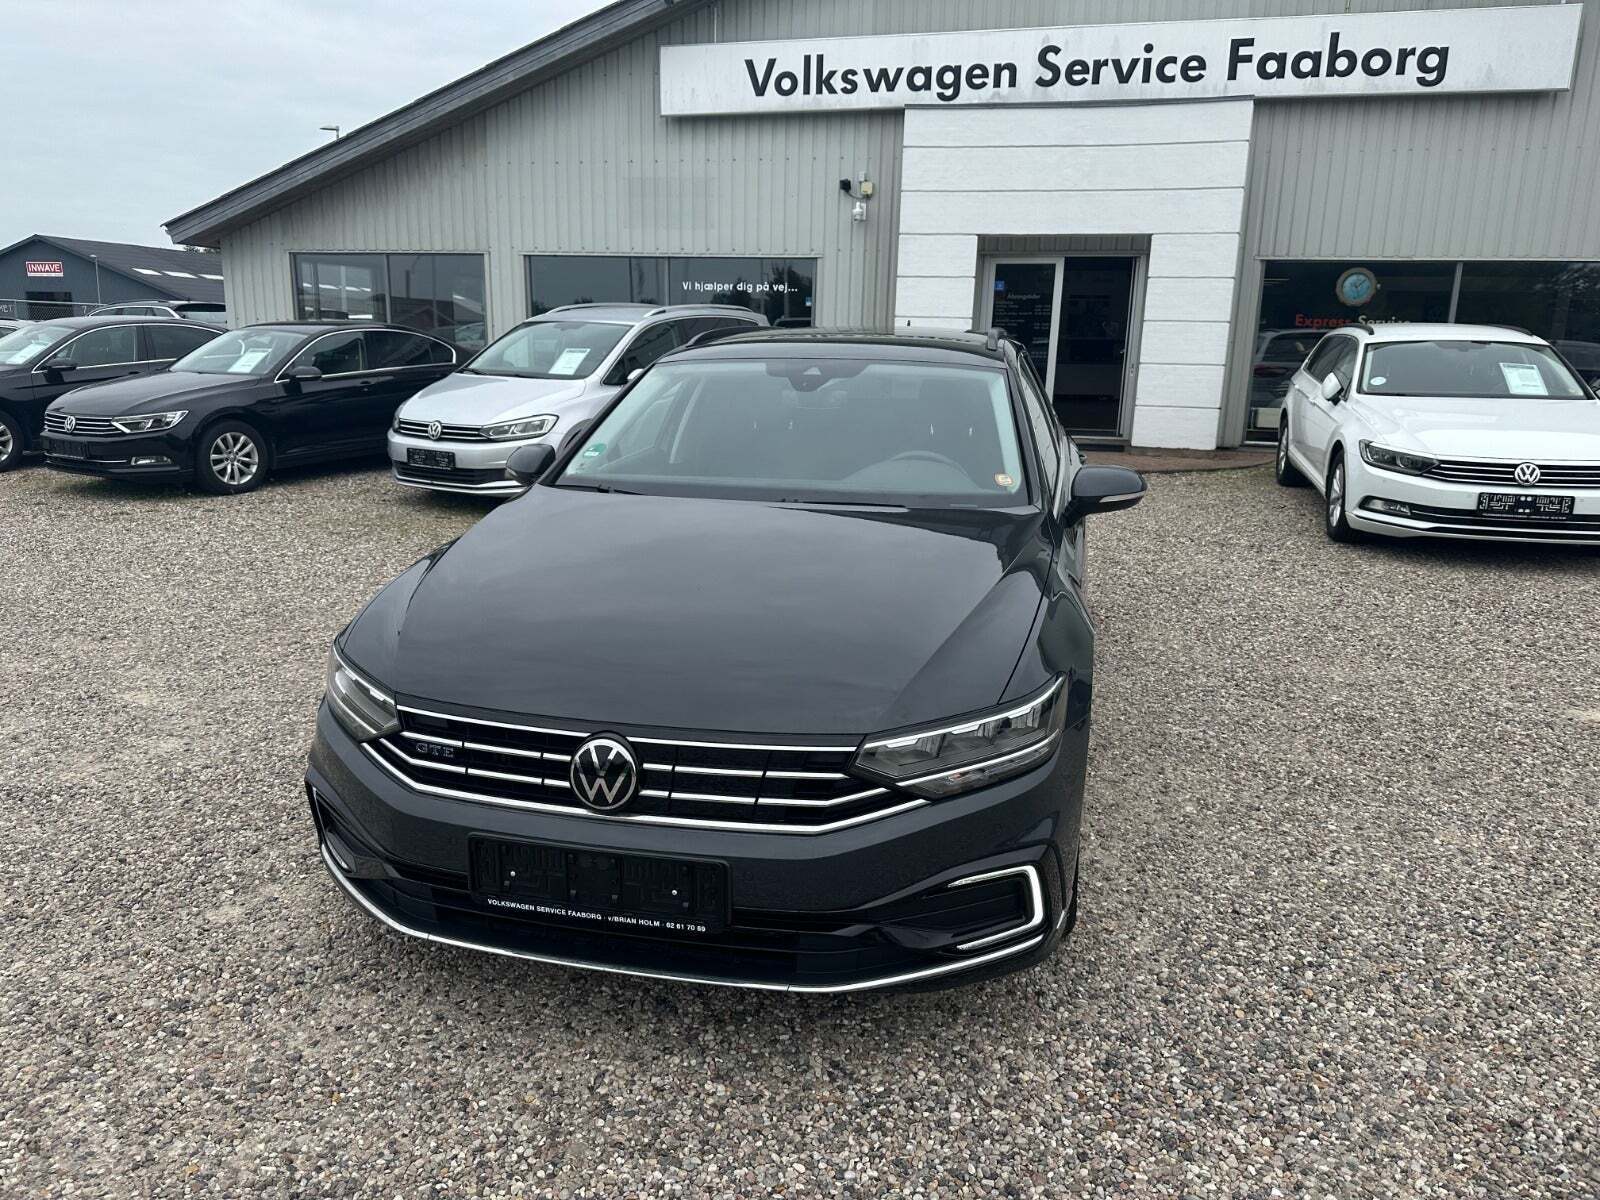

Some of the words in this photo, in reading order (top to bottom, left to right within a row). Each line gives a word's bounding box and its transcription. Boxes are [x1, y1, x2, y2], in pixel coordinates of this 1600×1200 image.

[744, 54, 1017, 101] Volkswagen
[1035, 42, 1206, 87] Service
[1226, 32, 1449, 87] Faaborg
[28, 263, 61, 272] INWAVE
[682, 281, 691, 290] Vi
[695, 281, 733, 292] hjælper
[736, 281, 753, 292] dig
[756, 281, 769, 292] på
[772, 281, 798, 293] vej...
[1514, 462, 1541, 486] VW
[415, 742, 455, 758] GTE
[571, 739, 637, 807] VW
[487, 898, 535, 911] VOLKSWAGEN
[536, 905, 567, 916] SERVICE
[568, 910, 602, 920] FAABORG
[607, 915, 637, 925] v/BRIAN
[638, 919, 660, 928] HOLM
[687, 924, 696, 932] 70
